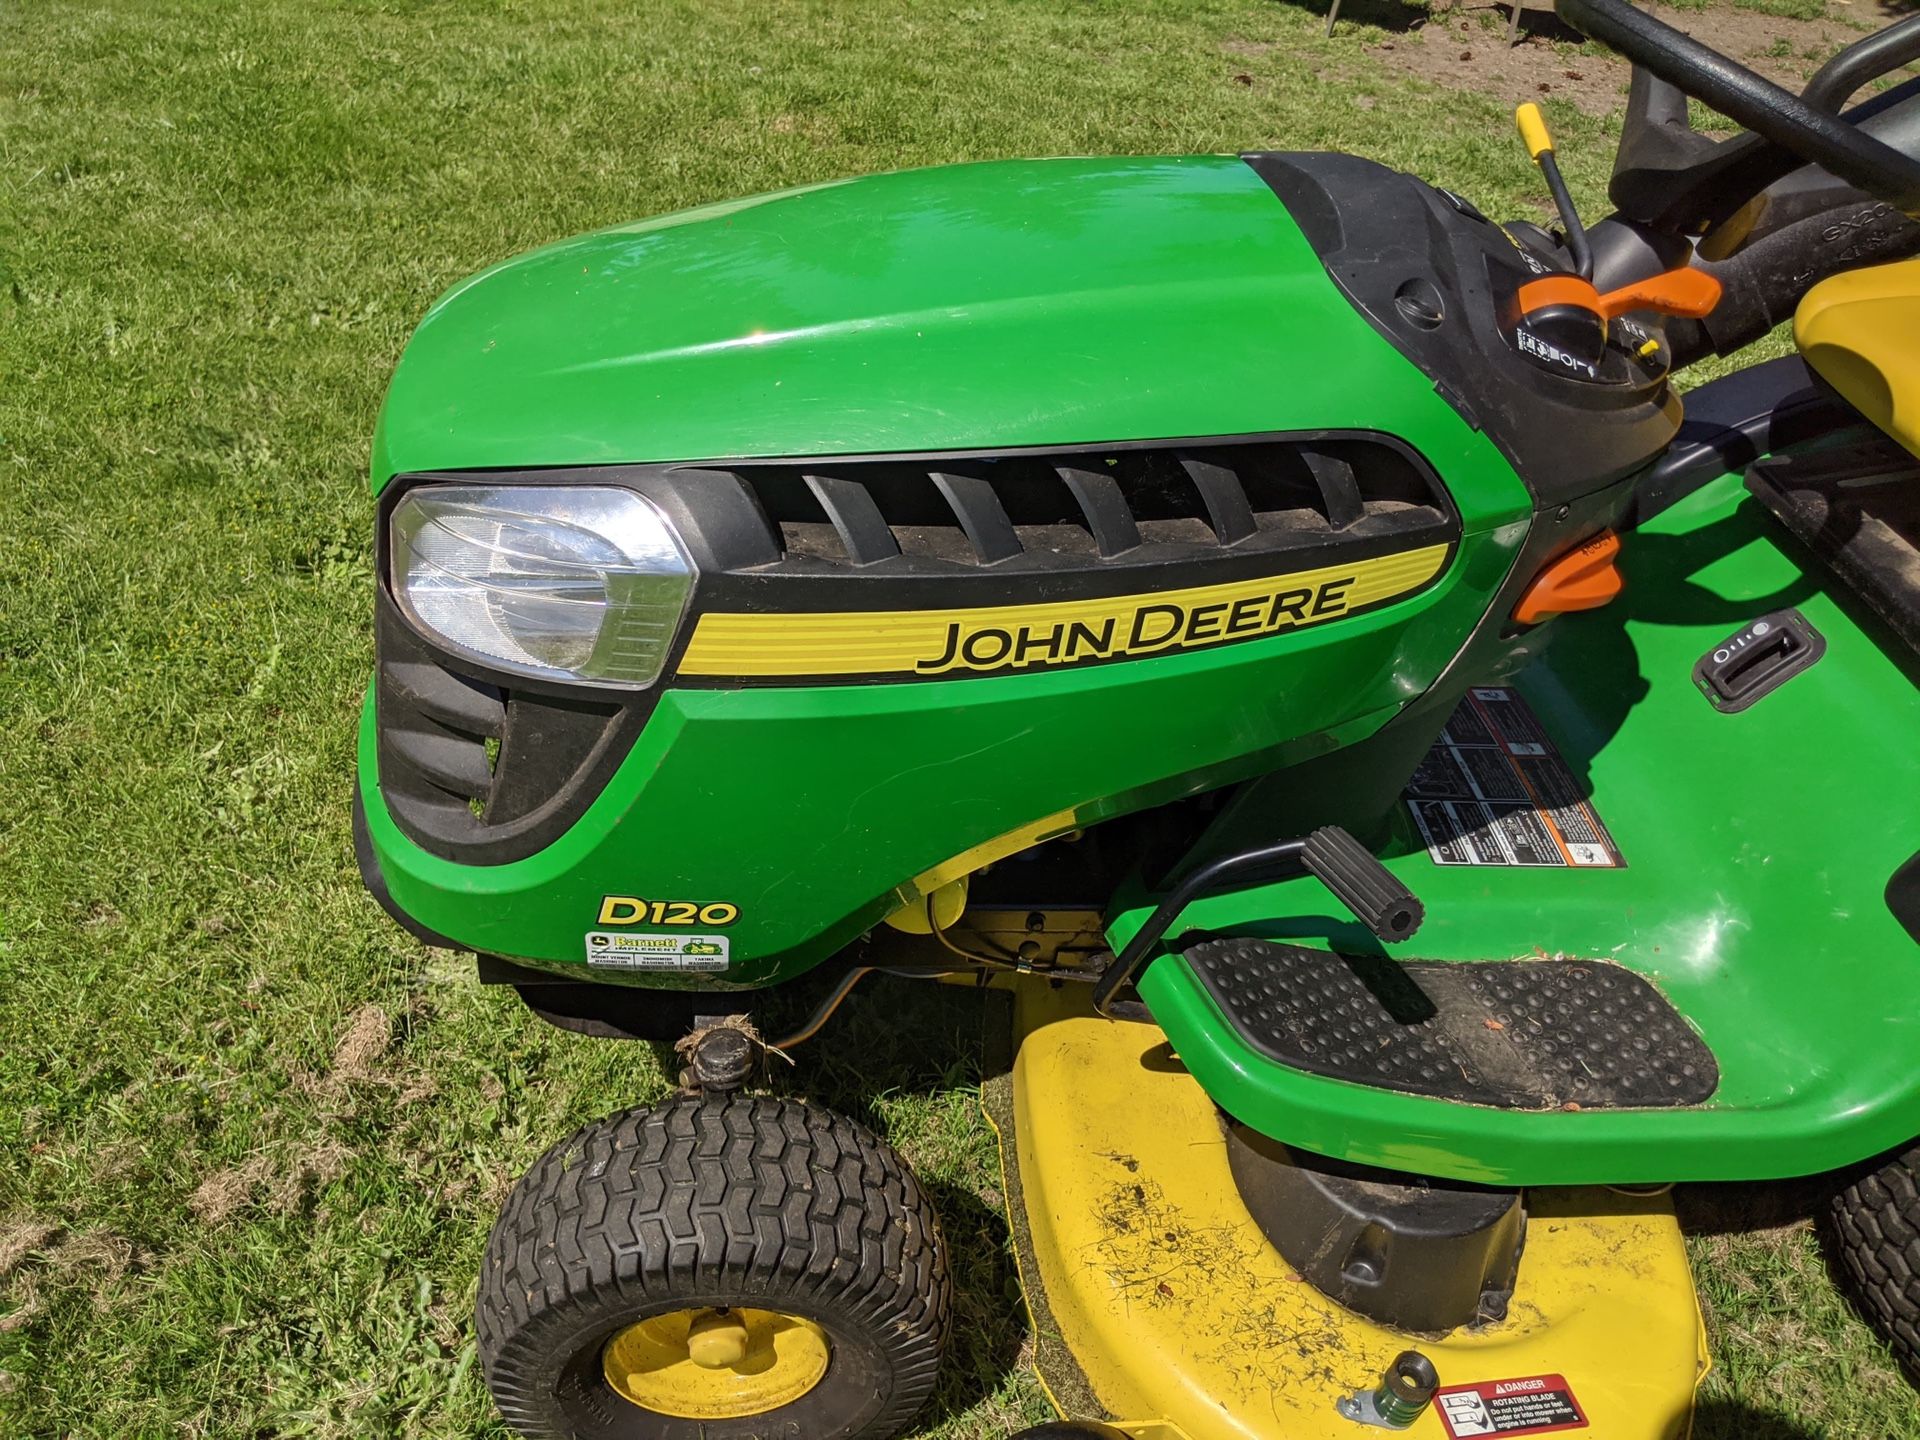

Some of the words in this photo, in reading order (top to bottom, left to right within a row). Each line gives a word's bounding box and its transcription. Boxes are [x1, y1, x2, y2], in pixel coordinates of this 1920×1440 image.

[916, 618, 1116, 669] JOHN
[1126, 576, 1356, 645] DEERE
[597, 895, 740, 926] D120
[614, 936, 678, 948] Barnett
[1504, 1380, 1546, 1392] DANGER
[1492, 1394, 1530, 1406] ROTATING
[1530, 1392, 1556, 1402] BLADE
[1513, 1406, 1523, 1414] put
[1524, 1403, 1543, 1411] hands
[1534, 1409, 1555, 1417] mower
[1497, 1420, 1519, 1429] engine
[1526, 1417, 1552, 1425] running
